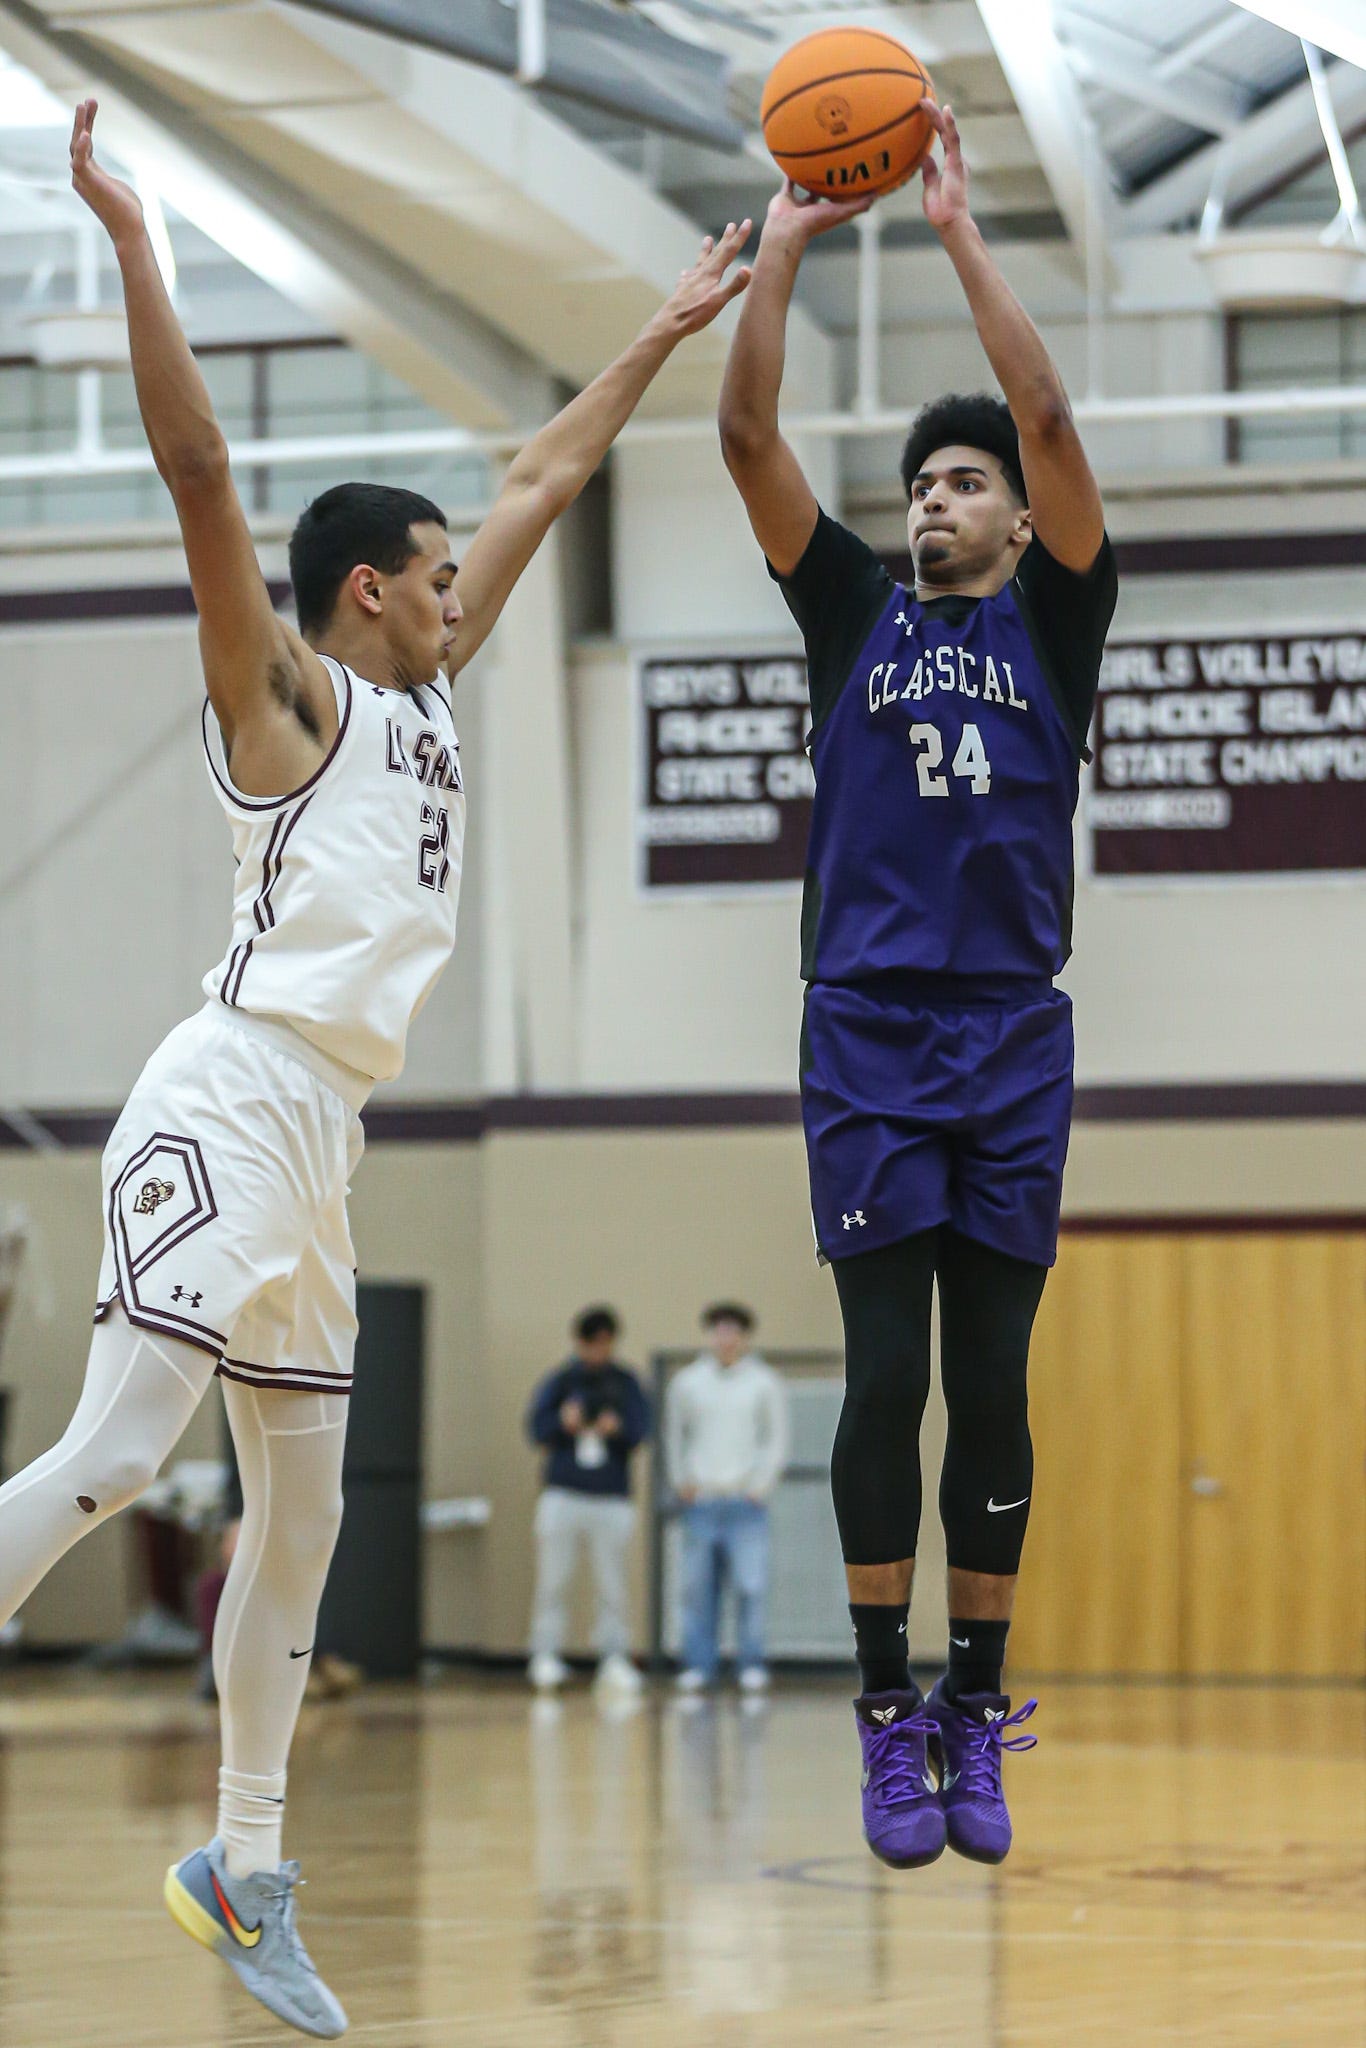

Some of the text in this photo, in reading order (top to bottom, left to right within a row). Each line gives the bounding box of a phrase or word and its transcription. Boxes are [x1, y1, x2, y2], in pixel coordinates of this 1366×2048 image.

[868, 645, 1028, 714] CLASSICAL
[1196, 637, 1366, 686] VOLLEYB
[1102, 691, 1251, 739] RHODE
[656, 756, 763, 802] STATE
[908, 723, 992, 797] 24
[1102, 740, 1215, 787] STATE
[417, 799, 450, 893] 21
